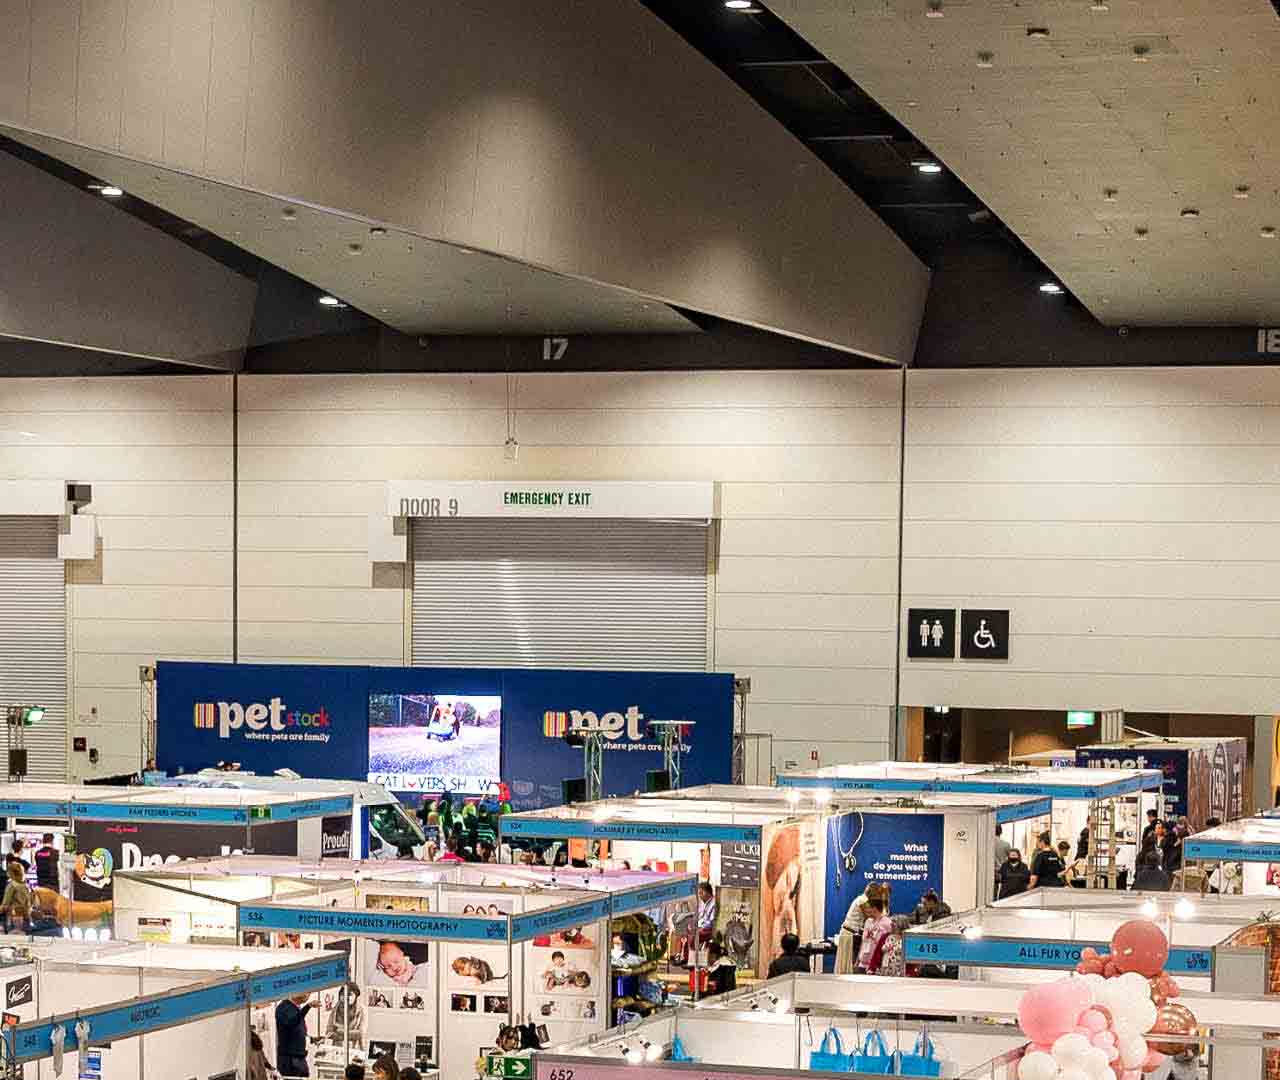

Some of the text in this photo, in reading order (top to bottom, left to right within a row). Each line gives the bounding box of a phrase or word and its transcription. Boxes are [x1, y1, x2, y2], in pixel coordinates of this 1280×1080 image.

[543, 338, 569, 360] 17
[503, 491, 591, 507] EMERGENCY EXIT
[399, 497, 459, 517] DOOR 9
[245, 731, 330, 743] where pets are family
[647, 744, 662, 752] are
[903, 843, 929, 852] What
[889, 854, 928, 862] moment
[873, 862, 928, 872] do you want
[863, 871, 874, 879] to
[875, 872, 922, 881] remember
[298, 914, 335, 926] PICTURE
[336, 917, 384, 928] MOMENTS
[386, 919, 459, 932] PHOTOGRAPHY
[1019, 947, 1038, 958] ALL
[1040, 948, 1061, 959] FUR
[1062, 949, 1082, 961] YO
